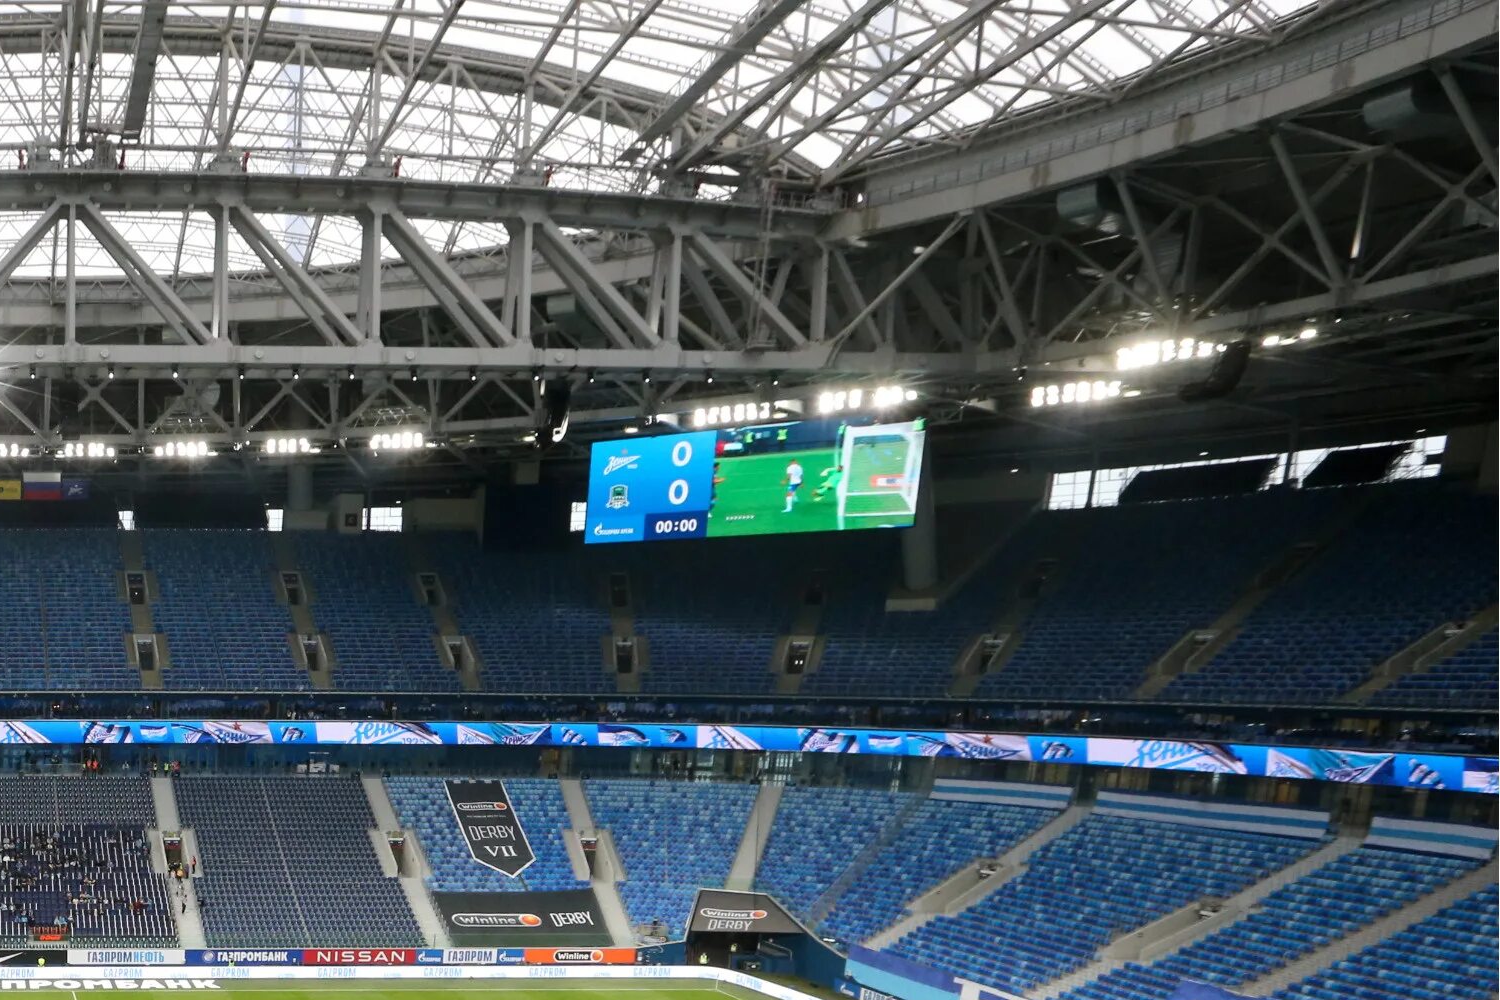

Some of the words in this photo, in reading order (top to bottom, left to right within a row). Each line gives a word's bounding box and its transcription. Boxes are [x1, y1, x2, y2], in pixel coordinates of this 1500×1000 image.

[672, 441, 692, 467] 0
[668, 479, 689, 504] 0
[655, 518, 697, 534] 00:00
[468, 825, 516, 841] DERBY
[483, 845, 518, 857] VII
[549, 910, 596, 928] DERBY
[707, 919, 754, 931] DERBY
[87, 951, 165, 963] ГАЗПРОМНЕФТЬ
[217, 951, 288, 962] ГАЗПРОМБАНК
[317, 950, 405, 962] NISSAN
[448, 950, 493, 962] ГАЗПРОМ
